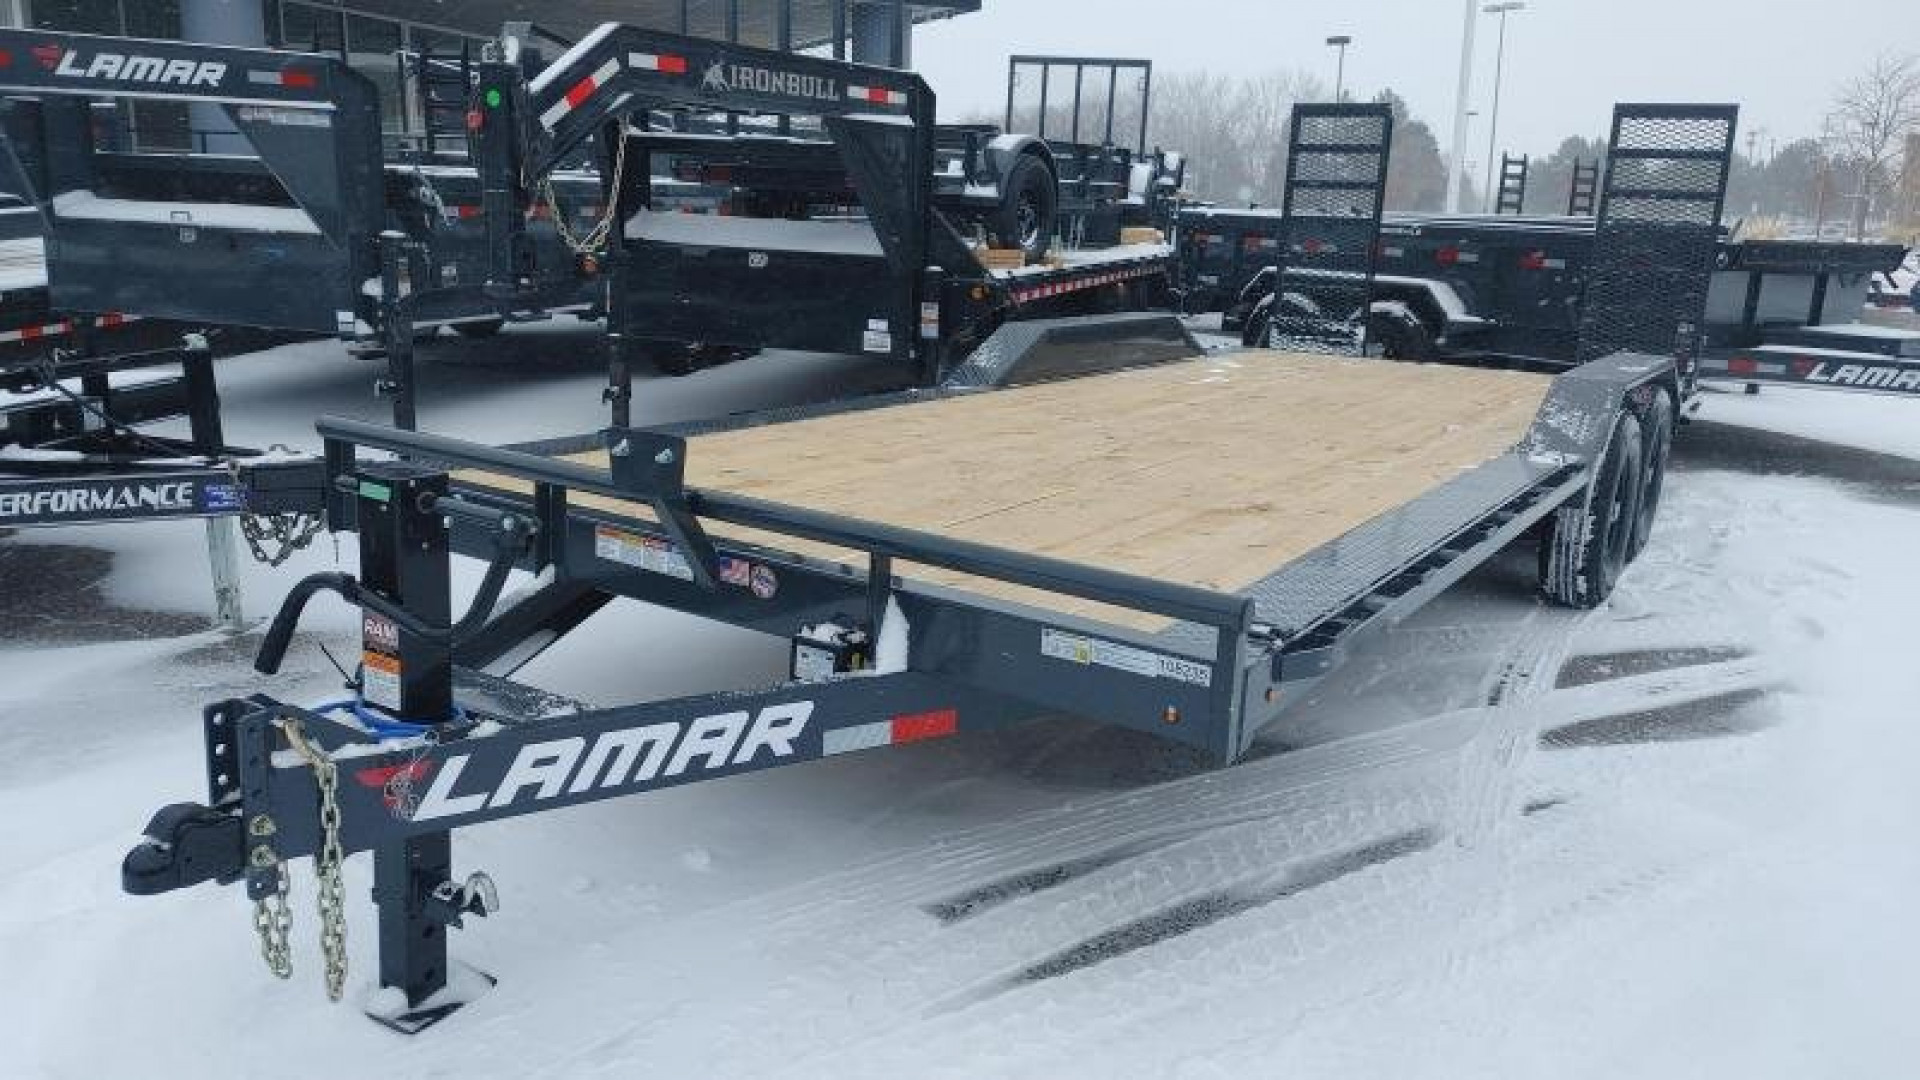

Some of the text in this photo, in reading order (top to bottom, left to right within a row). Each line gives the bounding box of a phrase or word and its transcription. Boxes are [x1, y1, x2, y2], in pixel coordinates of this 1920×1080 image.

[55, 49, 227, 87] LAMAR
[730, 64, 840, 101] IRONBULL
[412, 700, 815, 822] LAMAR
